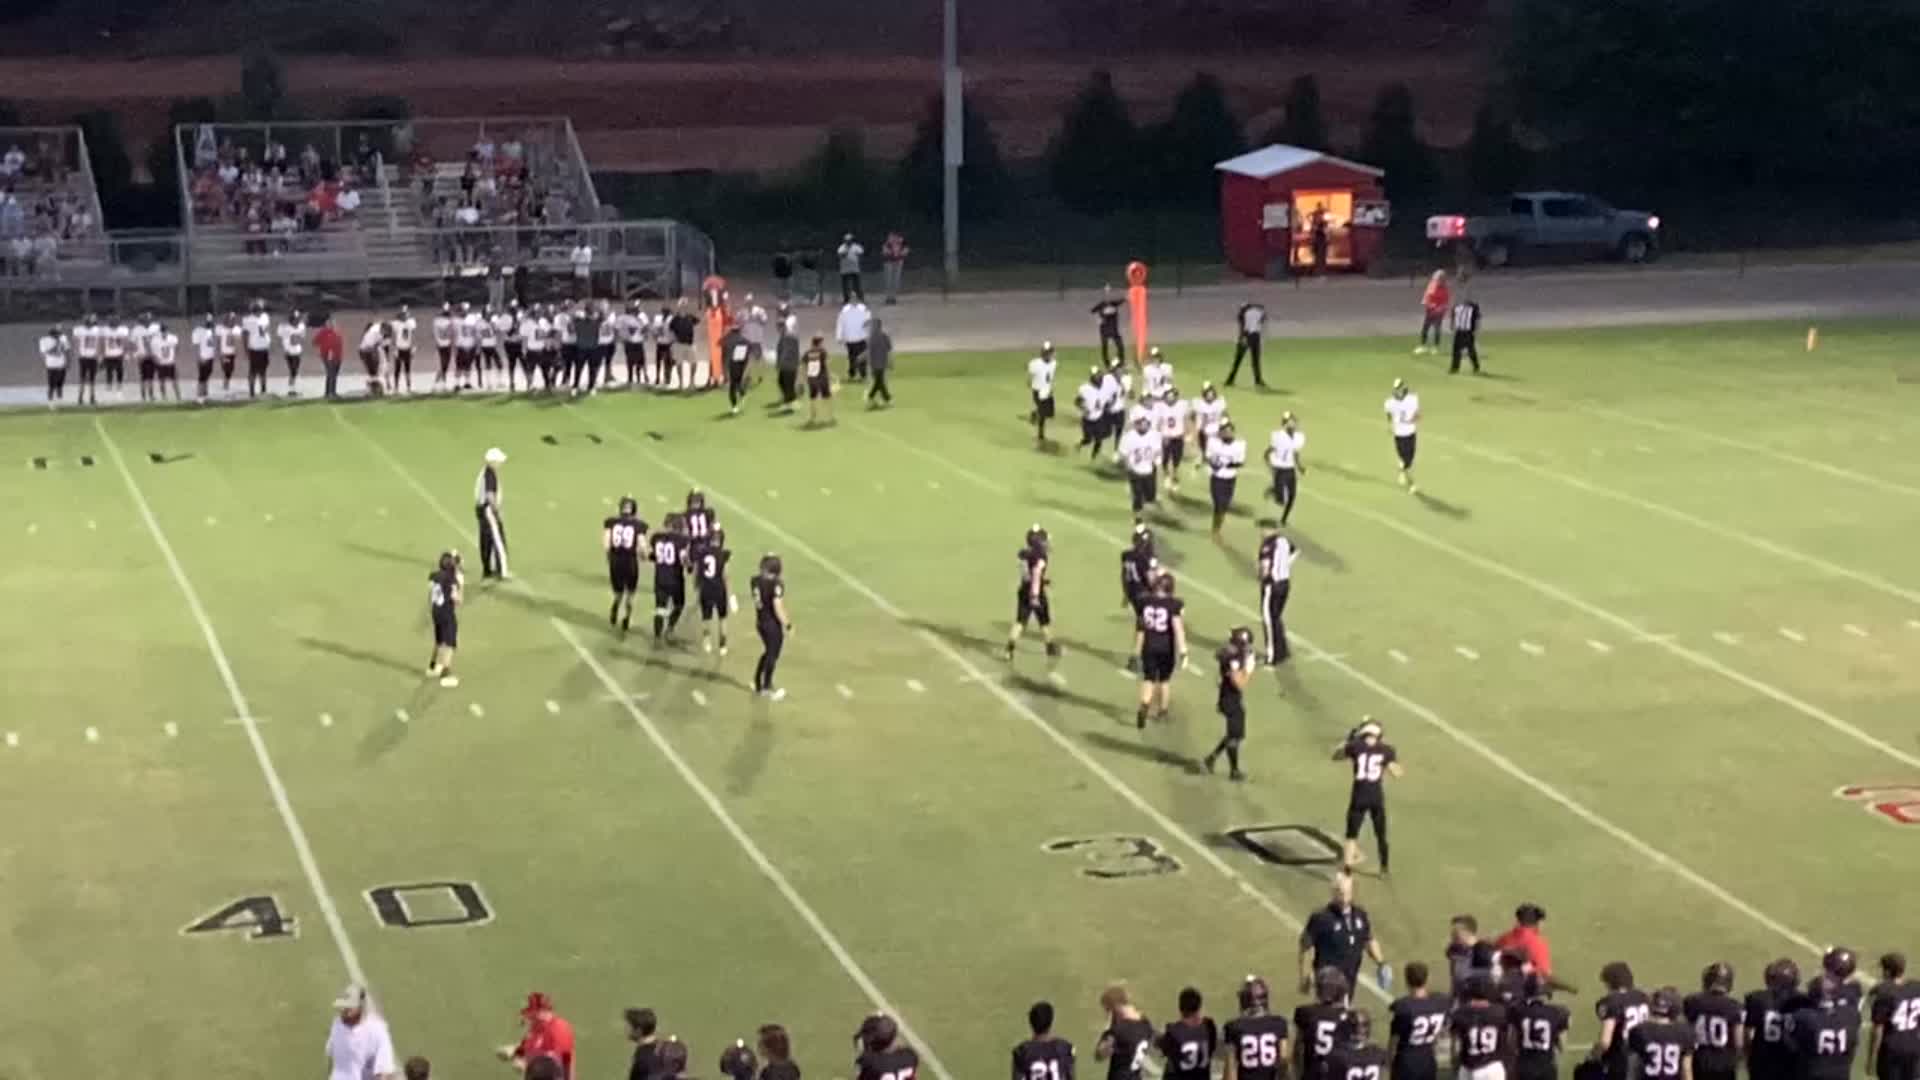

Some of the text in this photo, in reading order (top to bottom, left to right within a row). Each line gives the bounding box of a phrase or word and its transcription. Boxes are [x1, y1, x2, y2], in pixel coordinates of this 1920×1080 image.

[612, 523, 635, 549] 69
[690, 513, 707, 537] 11
[703, 554, 717, 579] 3
[1143, 605, 1168, 631] 62
[1314, 1020, 1337, 1055] 5
[1409, 1013, 1445, 1046] 27
[1467, 1025, 1498, 1056] 19
[1521, 1017, 1551, 1051] 13
[1817, 1028, 1847, 1055] 61
[1240, 1032, 1278, 1068] 26
[1645, 1041, 1680, 1076] 39
